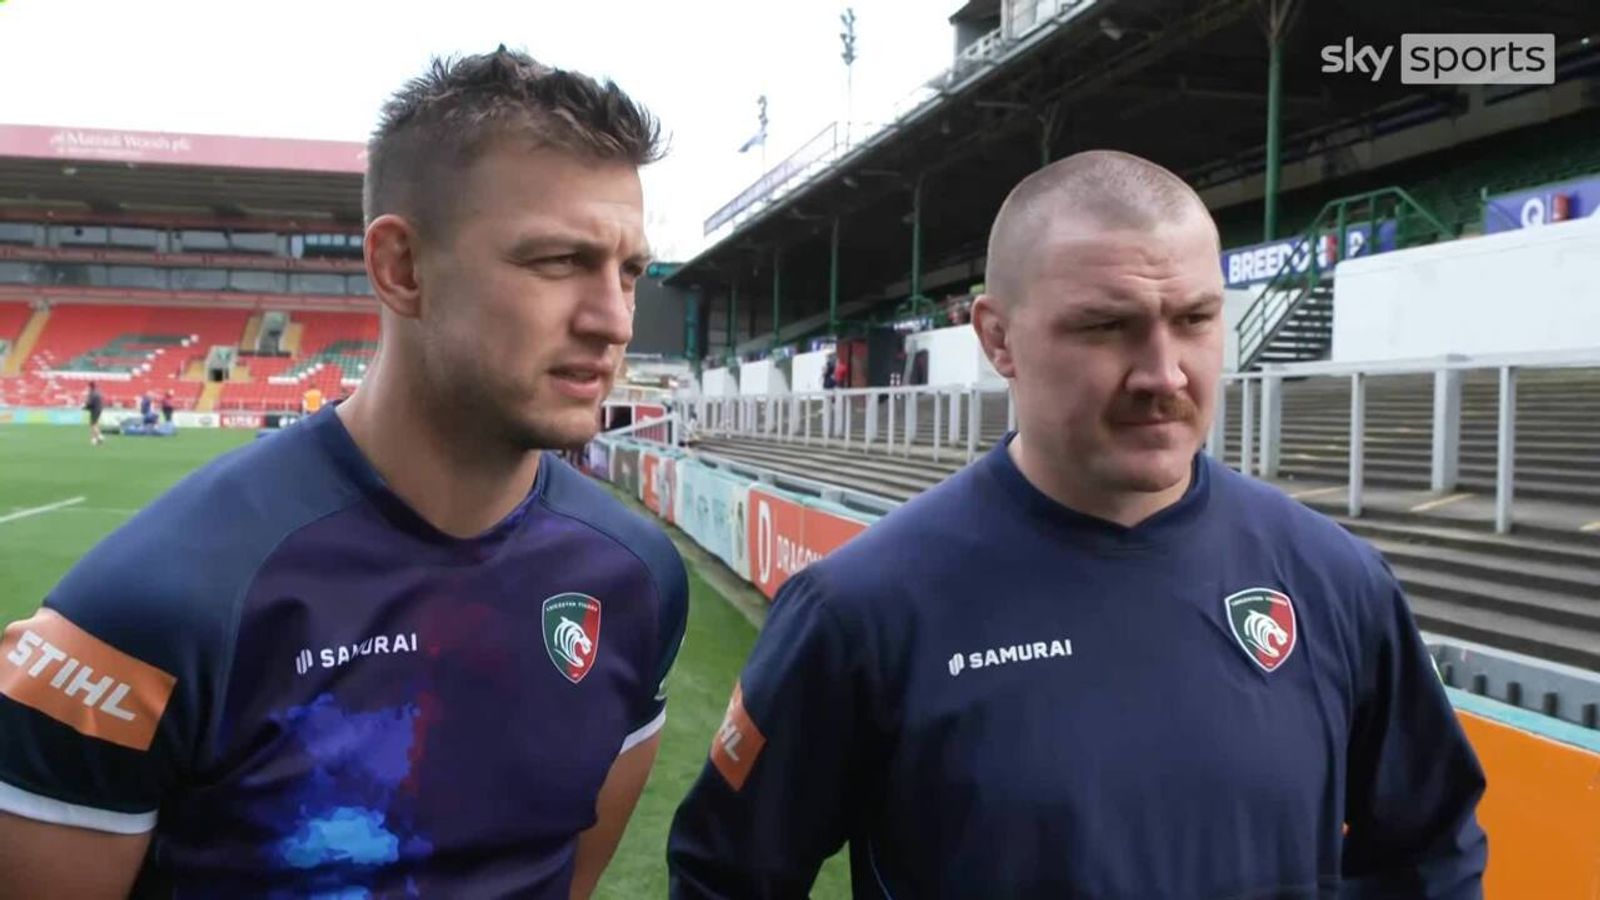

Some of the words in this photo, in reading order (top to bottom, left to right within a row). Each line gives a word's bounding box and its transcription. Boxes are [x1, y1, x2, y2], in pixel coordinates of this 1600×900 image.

[320, 632, 418, 668] SAMURAI
[968, 638, 1073, 669] SAMURAI
[7, 630, 136, 722] STIHL
